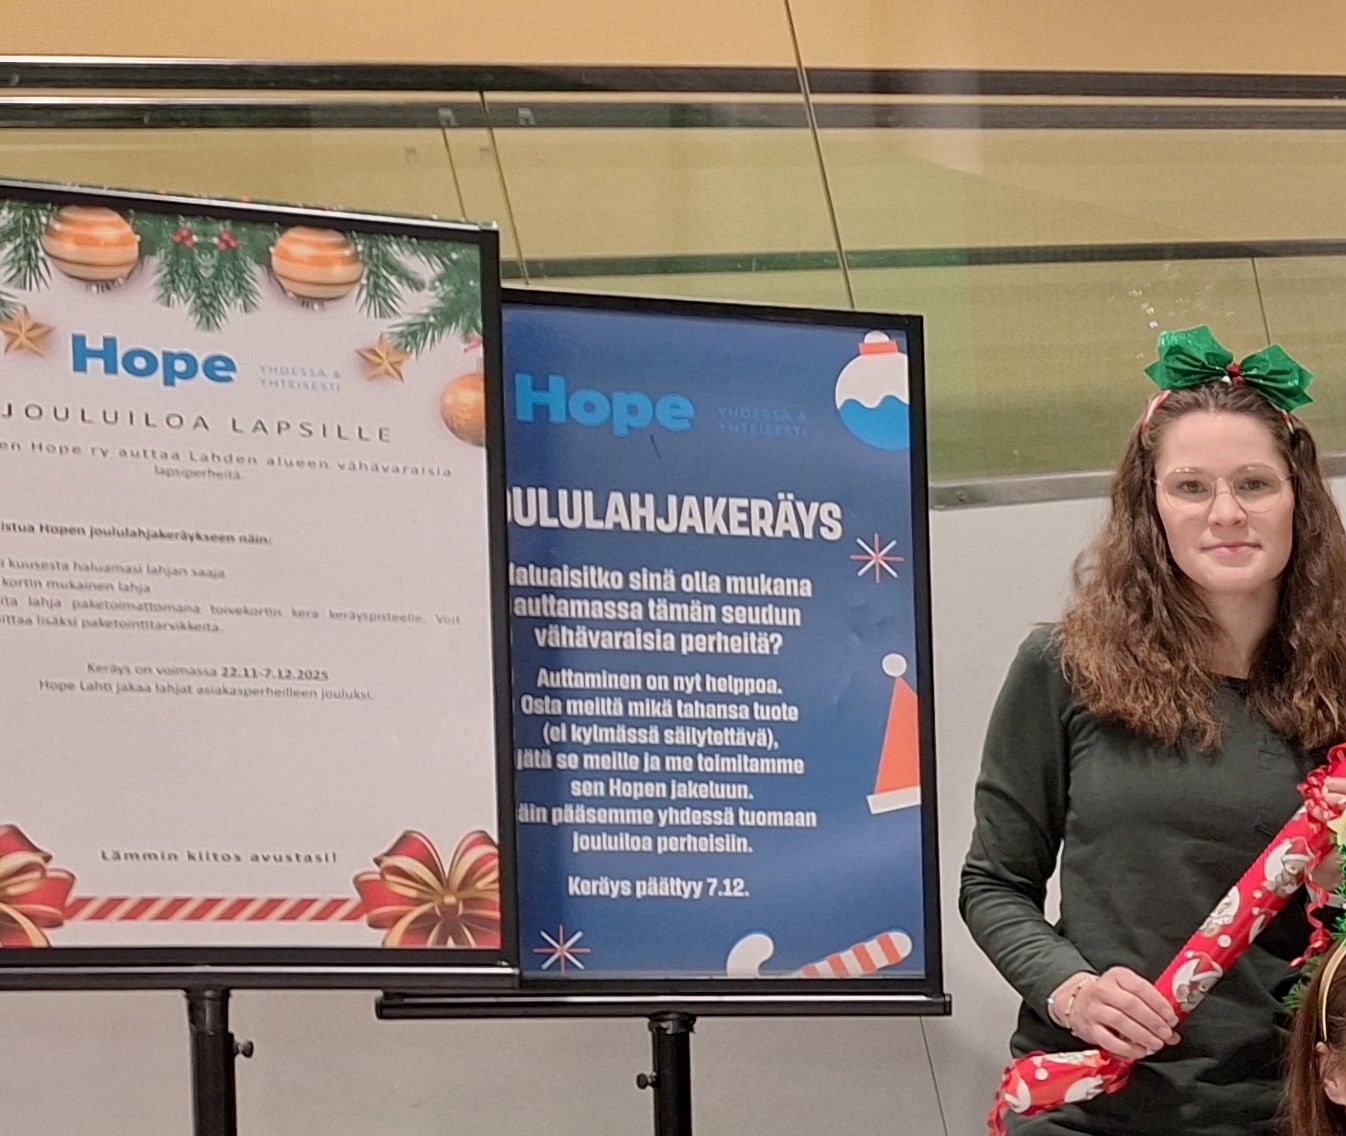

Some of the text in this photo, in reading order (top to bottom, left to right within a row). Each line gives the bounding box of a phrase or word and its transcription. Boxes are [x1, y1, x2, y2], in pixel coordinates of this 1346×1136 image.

[71, 333, 237, 387] Hope
[513, 372, 695, 437] Hope
[1, 402, 392, 443] JOULUILOA LAPSILLE
[31, 441, 82, 456] Hope
[91, 446, 109, 458] ry
[118, 449, 181, 461] auttaa
[188, 450, 258, 465] Lahden
[266, 455, 329, 469] alueen
[337, 460, 452, 477] vähävaraisia
[39, 523, 86, 537] Hopen
[89, 525, 235, 543] joululahjakeräykseen
[238, 533, 271, 545] näin:
[8, 558, 69, 572] kuusesta
[73, 560, 143, 574] haluamasi
[146, 562, 188, 577] lahjan
[46, 579, 114, 591] mukainen
[118, 581, 151, 595] lahja
[628, 567, 676, 592] sinä
[681, 570, 720, 594] olla
[726, 573, 812, 597] mukana
[28, 596, 62, 610] lahja
[72, 599, 200, 614] paketoimattomana
[210, 604, 282, 617] toivekortin
[291, 608, 319, 619] kera
[435, 614, 461, 625] Voit
[36, 615, 77, 627] lisäksi
[513, 596, 801, 627] auttamassa tämän seudun
[534, 625, 783, 656] vähävaraisia perheitä?
[87, 662, 131, 676] Keräys
[135, 665, 151, 674] on
[155, 665, 218, 677] voimassa
[537, 667, 783, 696] Auttaminen on nyt helppoa.
[39, 679, 76, 692] Hope
[116, 681, 152, 694] jakaa
[520, 695, 799, 722] Osta meiltä mikä tahansa tuote
[543, 722, 779, 750] (ei kylmässä säilytettävä),
[556, 752, 579, 770] se
[583, 750, 639, 771] meille
[643, 752, 661, 773] ja
[665, 755, 693, 773] me
[697, 753, 804, 775] toimitamme
[571, 778, 754, 801] sen Hopen jakeluun.
[552, 803, 654, 826] pääsemme
[657, 806, 734, 828] yhdessä
[738, 808, 817, 828] tuomaan
[572, 830, 753, 855] jouluiloa perheisiin.
[101, 849, 337, 864] Lämmin kiitos avustasi!
[568, 875, 750, 900] Keräys päättyy 7.12.
